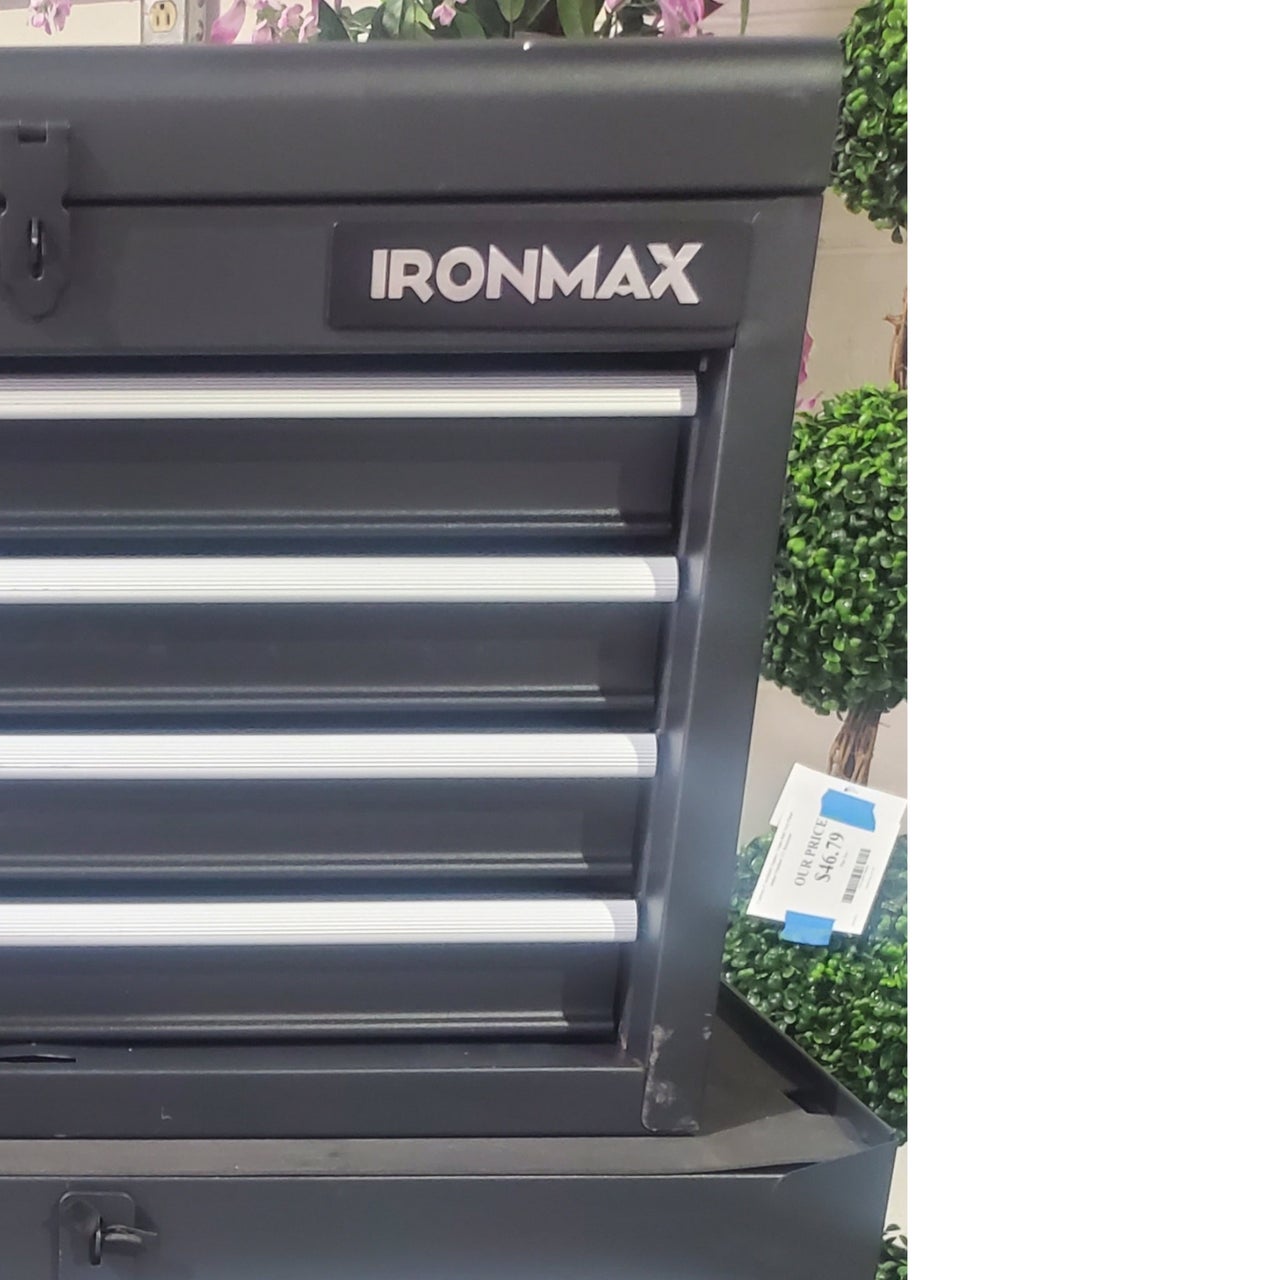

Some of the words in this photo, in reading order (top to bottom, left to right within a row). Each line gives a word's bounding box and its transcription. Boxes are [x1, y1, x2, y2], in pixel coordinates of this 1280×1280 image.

[370, 242, 703, 305] IRONMAX
[794, 859, 813, 886] OUR
[804, 818, 828, 856] PRICE
[815, 832, 844, 883] $46.79
